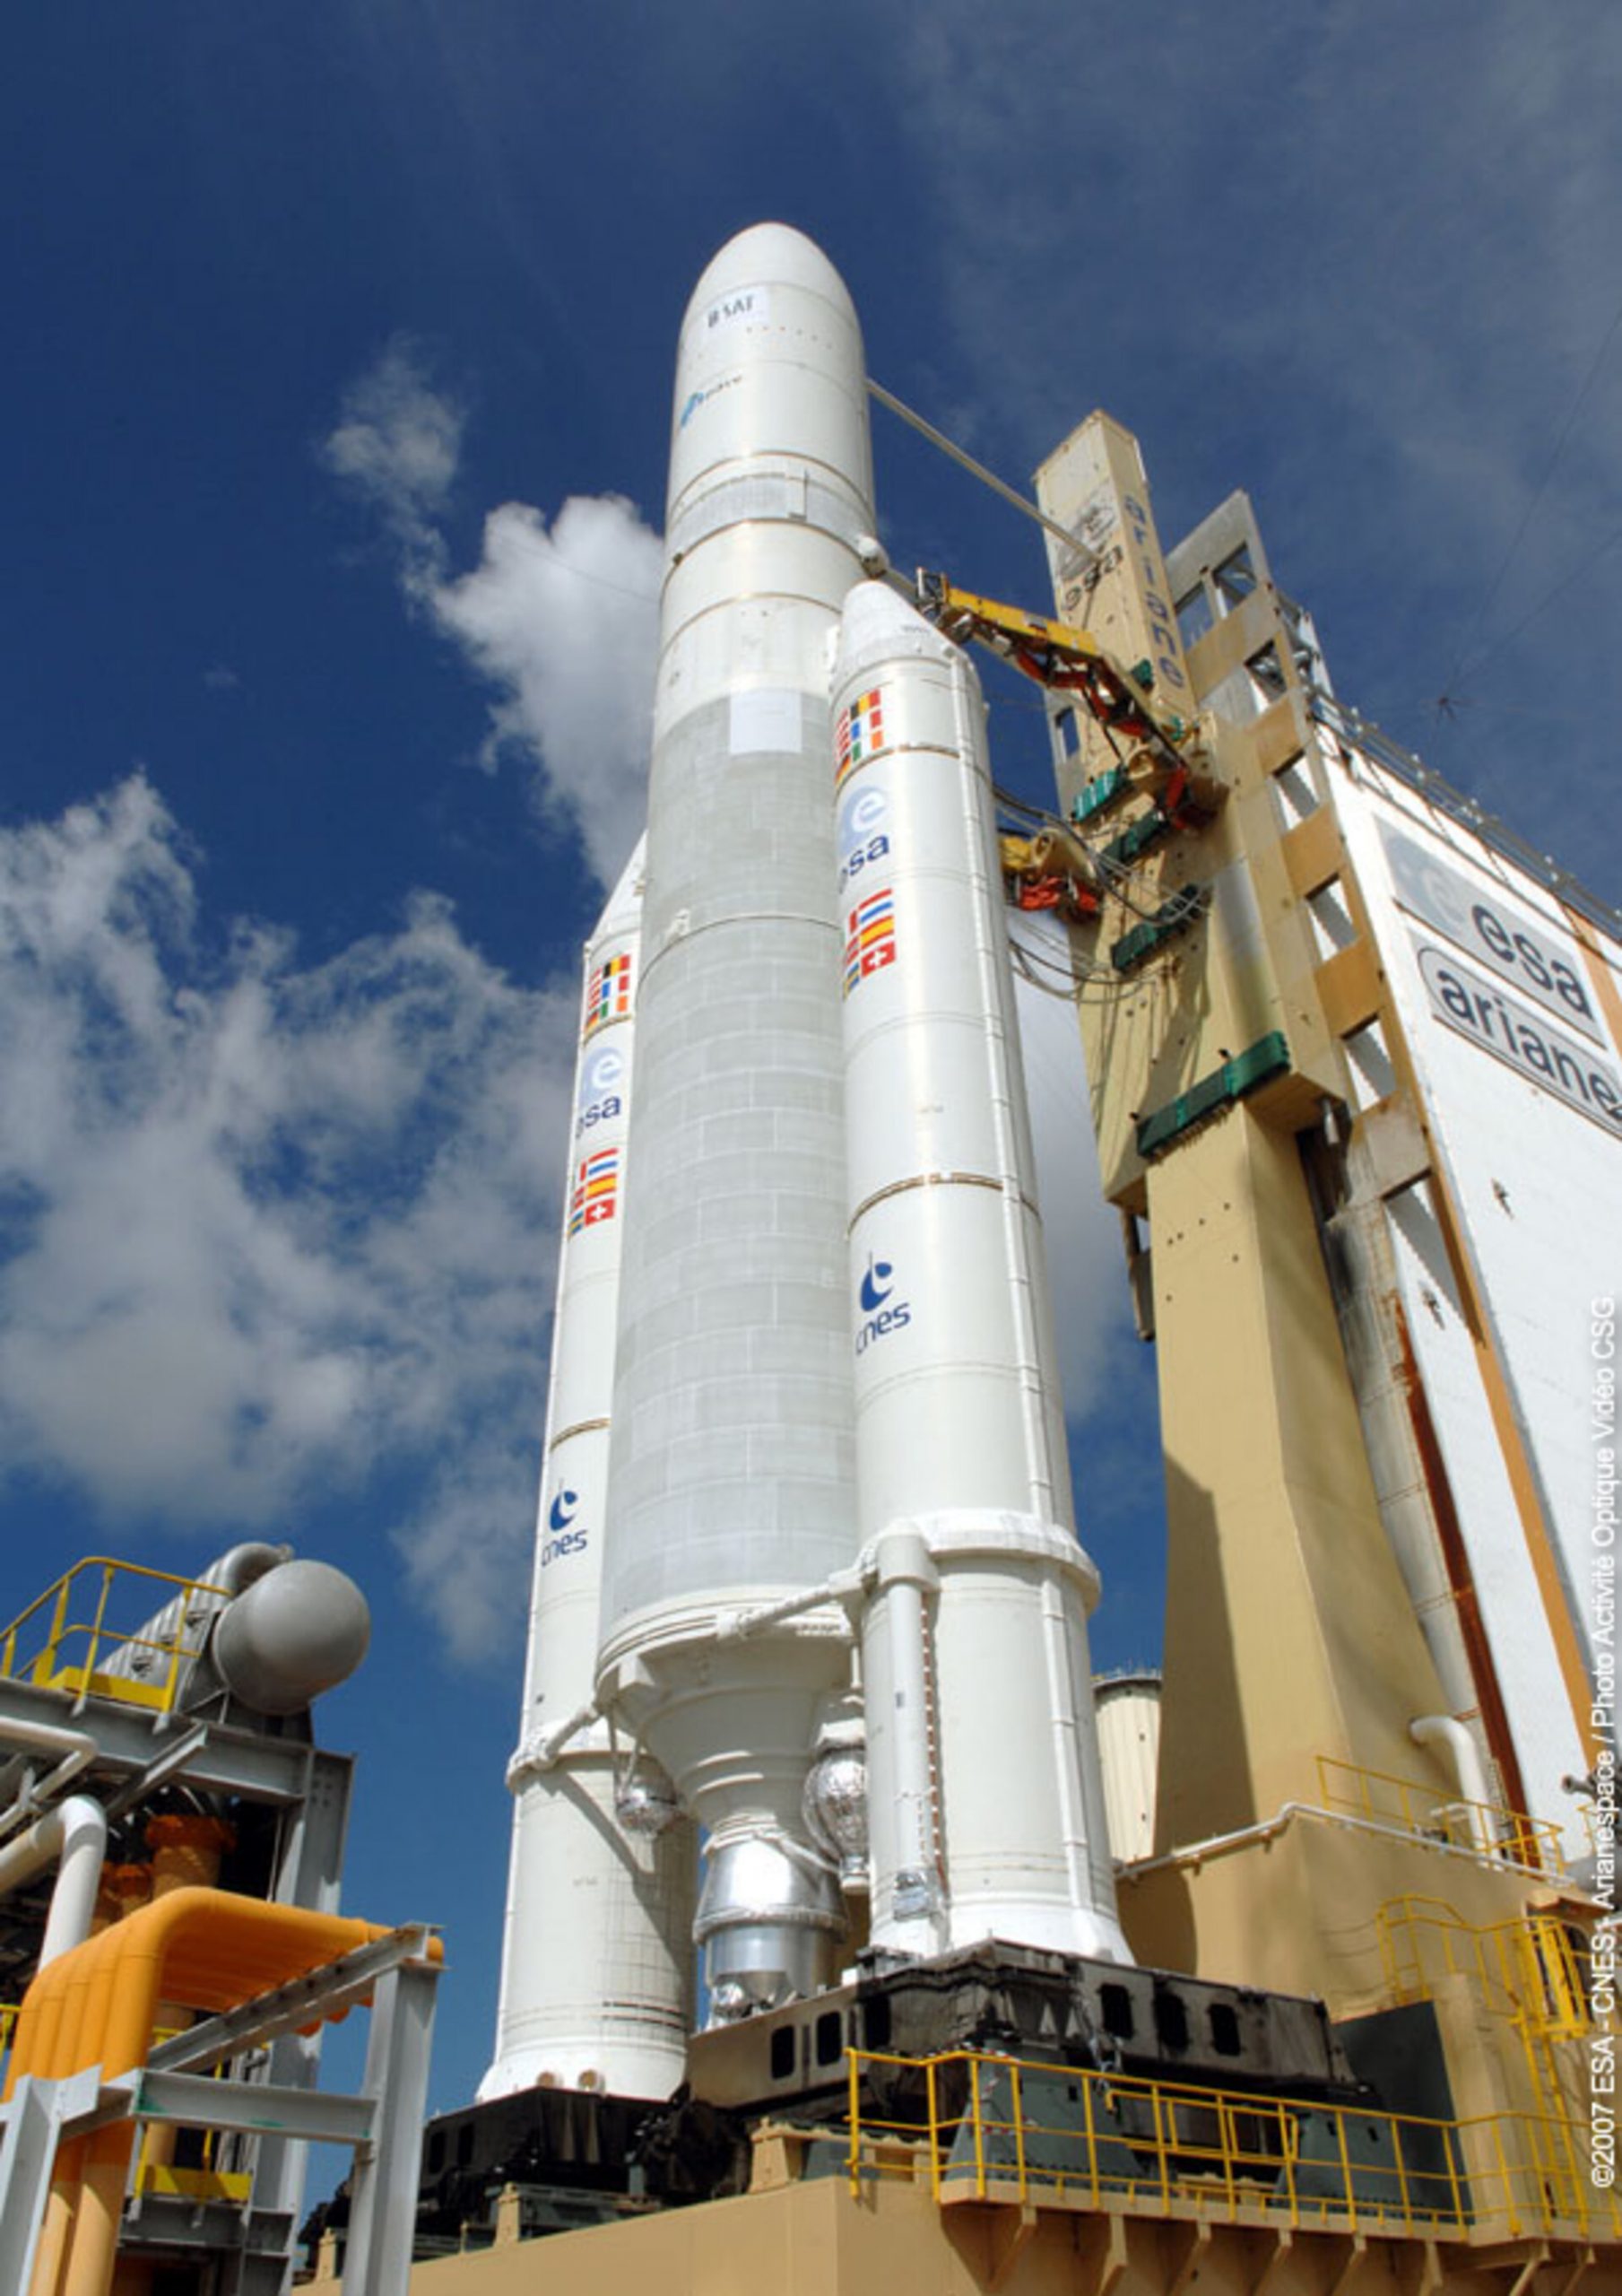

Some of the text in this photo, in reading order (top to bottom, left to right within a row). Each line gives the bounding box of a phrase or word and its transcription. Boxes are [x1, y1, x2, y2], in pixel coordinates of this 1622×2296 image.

[1472, 905, 1595, 1022] esa
[1437, 970, 1622, 1121] ariane
[855, 1302, 911, 1356] cnes
